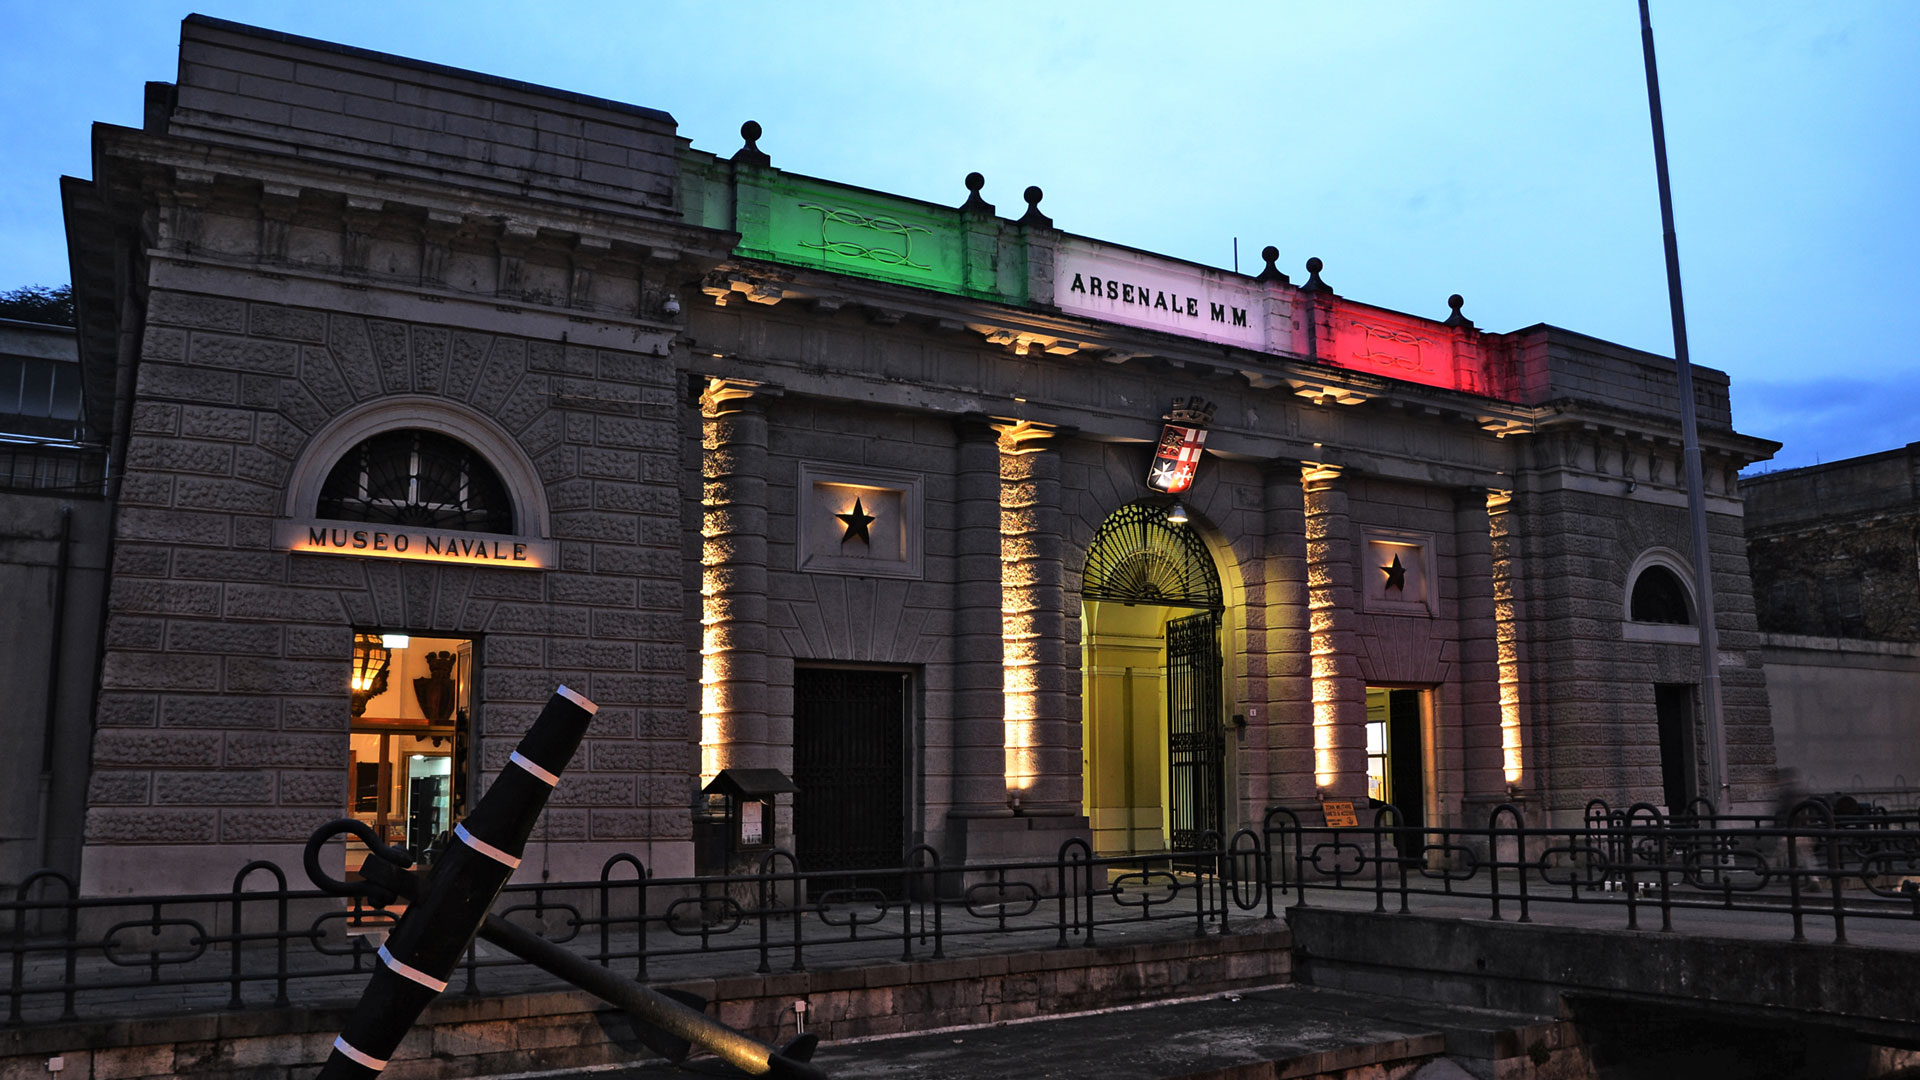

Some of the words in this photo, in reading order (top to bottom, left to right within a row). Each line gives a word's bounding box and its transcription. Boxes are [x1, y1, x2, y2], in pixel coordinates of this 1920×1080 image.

[1071, 273, 1198, 317] ARSENALE
[308, 527, 409, 552] MUSEO
[425, 536, 527, 560] NAVALE
